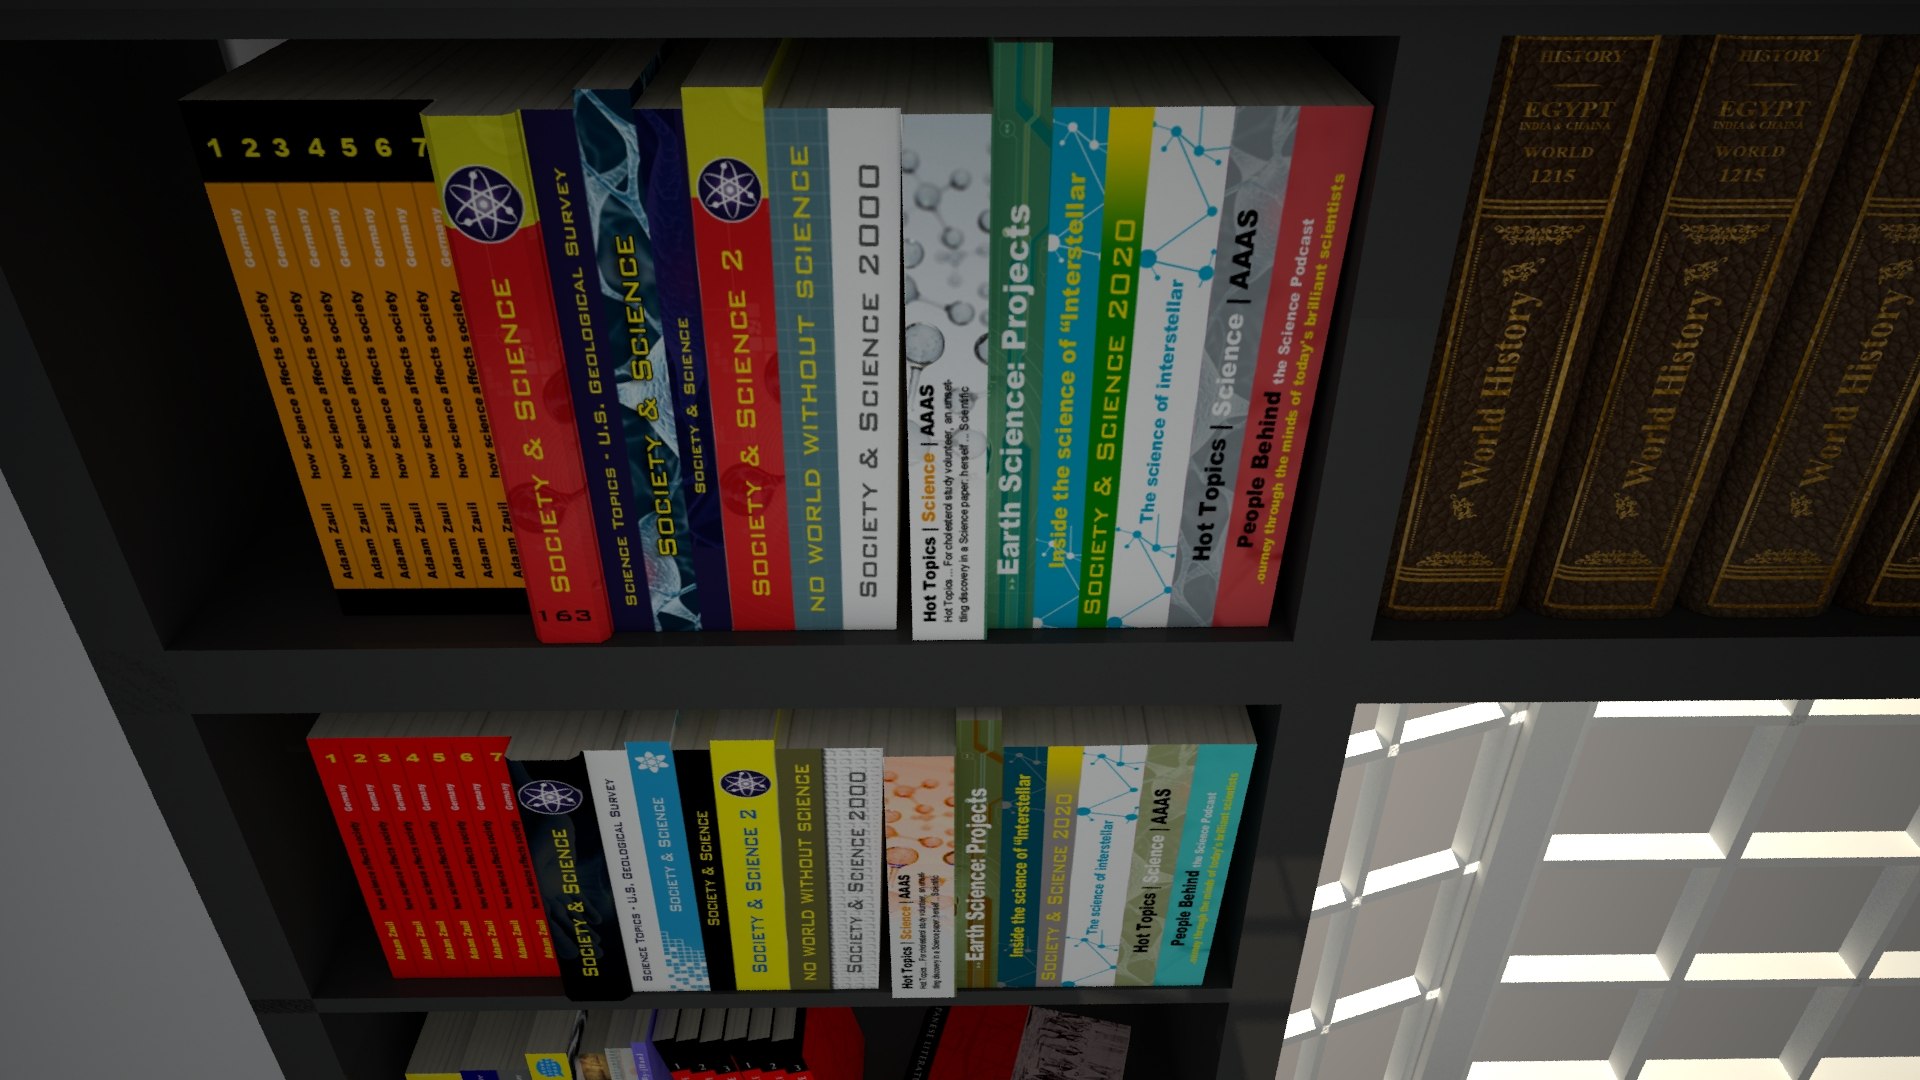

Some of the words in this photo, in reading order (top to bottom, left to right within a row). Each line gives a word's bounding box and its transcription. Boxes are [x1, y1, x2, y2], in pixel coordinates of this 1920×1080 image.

[1540, 49, 1628, 64] HISTORY
[1739, 48, 1825, 63] HISTORY
[1521, 101, 1617, 118] EGYPT
[1719, 100, 1811, 117] EGYPT
[207, 138, 222, 158] 1
[241, 138, 260, 158] 2
[272, 138, 290, 158] 3
[308, 138, 326, 158] 4
[340, 138, 358, 158] 5
[375, 138, 393, 158] 6
[411, 138, 426, 158] 7
[1523, 146, 1594, 159] WORLD
[1716, 145, 1785, 158] WORLD
[1531, 168, 1577, 184] 1215
[1719, 168, 1766, 183] 1215
[553, 167, 580, 257] SURVEY
[790, 145, 814, 299] SCIENCE
[859, 164, 880, 276] 2000
[1320, 172, 1346, 259] scientists
[230, 207, 256, 268] Germany
[720, 248, 744, 271] 2
[1230, 209, 1258, 290] AAAS
[1290, 218, 1315, 288] Podcast
[1001, 204, 1035, 350] Projects
[1108, 219, 1136, 320] 2020
[256, 290, 276, 343] society
[615, 234, 653, 381] SCIENCE
[1304, 263, 1328, 326] brilliant
[571, 266, 603, 395] GEOLOGICAL
[1156, 279, 1184, 389] interstellar
[1278, 292, 1301, 356] Science
[1480, 291, 1543, 398] History
[275, 346, 295, 395] affects
[491, 277, 537, 422] SCIENCE
[678, 317, 696, 396] SCIENCE
[728, 289, 757, 429] SCIENCE
[860, 293, 880, 432] SCIENCE
[1058, 339, 1078, 364] of
[1212, 313, 1244, 417] Science
[1272, 359, 1288, 385] the
[636, 397, 659, 421] &
[798, 315, 821, 456] WITHOUT
[1096, 334, 1126, 461] SCIENCE
[1155, 391, 1170, 412] of
[1290, 386, 1303, 406] of
[1622, 404, 1676, 490] World
[1652, 289, 1724, 398] History
[1800, 404, 1859, 487] World
[1836, 288, 1914, 398] History
[291, 398, 312, 450] science
[593, 403, 611, 447] U.S.
[685, 403, 700, 418] &
[920, 384, 935, 437] AAAS
[944, 412, 952, 424] an
[999, 355, 1026, 492] Science:
[1055, 371, 1076, 460] science
[1252, 391, 1281, 469] Behind
[1281, 409, 1298, 453] minds
[308, 452, 321, 480] how
[522, 438, 544, 461] &
[689, 424, 707, 495] SOCIETY
[740, 444, 760, 468] &
[860, 447, 879, 469] &
[959, 444, 968, 476] herself
[1147, 418, 1166, 487] science
[1274, 456, 1289, 480] the
[1458, 404, 1507, 490] World
[604, 467, 625, 530] TOPICS
[643, 434, 678, 557] SOCIETY
[920, 452, 936, 523] Science
[943, 476, 954, 500] study
[1052, 466, 1070, 502] the
[1093, 476, 1114, 496] &
[1198, 438, 1227, 517] Topics
[321, 502, 340, 534] Zauil
[805, 468, 823, 565] WORLD
[944, 502, 952, 550] cholesterol
[959, 510, 968, 544] Science
[1140, 492, 1156, 524] The
[1237, 477, 1266, 548] People
[1264, 482, 1286, 548] through
[532, 475, 571, 594] SOCIETY
[745, 480, 772, 597] SOCIETY
[860, 482, 878, 598] SOCIETY
[960, 554, 968, 562] in
[996, 501, 1021, 576] Earth
[1048, 507, 1068, 568] Inside
[1192, 522, 1214, 560] Hot
[335, 538, 354, 580] Adam
[616, 536, 637, 607] SCIENCE
[922, 536, 939, 589] Topics
[944, 552, 952, 566] For
[1084, 508, 1109, 615] SOCIETY
[1256, 548, 1274, 584] ourney
[808, 576, 826, 612] NO
[923, 591, 937, 623] Hot
[943, 579, 954, 606] Topics
[959, 564, 970, 604] discovery
[538, 609, 592, 623] 163
[944, 608, 952, 622] Hot
[604, 778, 621, 818] SURVEY
[740, 809, 758, 820] 2
[794, 763, 813, 832] SCIENCE
[849, 772, 866, 821] 2000
[1052, 793, 1074, 840] 2020
[1150, 788, 1172, 825] AAAS
[1200, 791, 1217, 824] Podcast
[652, 796, 672, 848] SCIENCE
[964, 787, 992, 854] Projects
[1194, 824, 1210, 856] Science
[551, 828, 581, 895] SCIENCE
[614, 822, 633, 880] GEOLOGICAL
[661, 852, 674, 862] &
[744, 827, 762, 891] SCIENCE
[848, 828, 866, 893] SCIENCE
[1094, 819, 1115, 871] interstellar
[1142, 834, 1164, 884] Science
[664, 866, 682, 913] SOCIETY
[798, 838, 815, 905] WITHOUT
[964, 858, 987, 921] Science:
[1047, 846, 1069, 905] SCIENCE
[1095, 870, 1107, 882] of
[1178, 870, 1200, 908] Behind
[566, 900, 585, 914] &
[748, 899, 764, 910] &
[848, 900, 864, 910] &
[1046, 911, 1061, 920] &
[1090, 882, 1102, 917] science
[1136, 892, 1156, 931] Topics
[573, 918, 600, 978] SOCIETY
[632, 913, 645, 944] TOPICS
[750, 916, 768, 974] SOCIETY
[802, 909, 816, 958] WORLD
[848, 917, 864, 974] SOCIETY
[964, 924, 986, 962] Earth
[1086, 918, 1099, 936] The
[1133, 934, 1150, 953] Hot
[1170, 909, 1192, 947] People
[638, 946, 653, 982] SCIENCE
[802, 962, 817, 982] NO
[1041, 926, 1060, 981] SOCIETY
